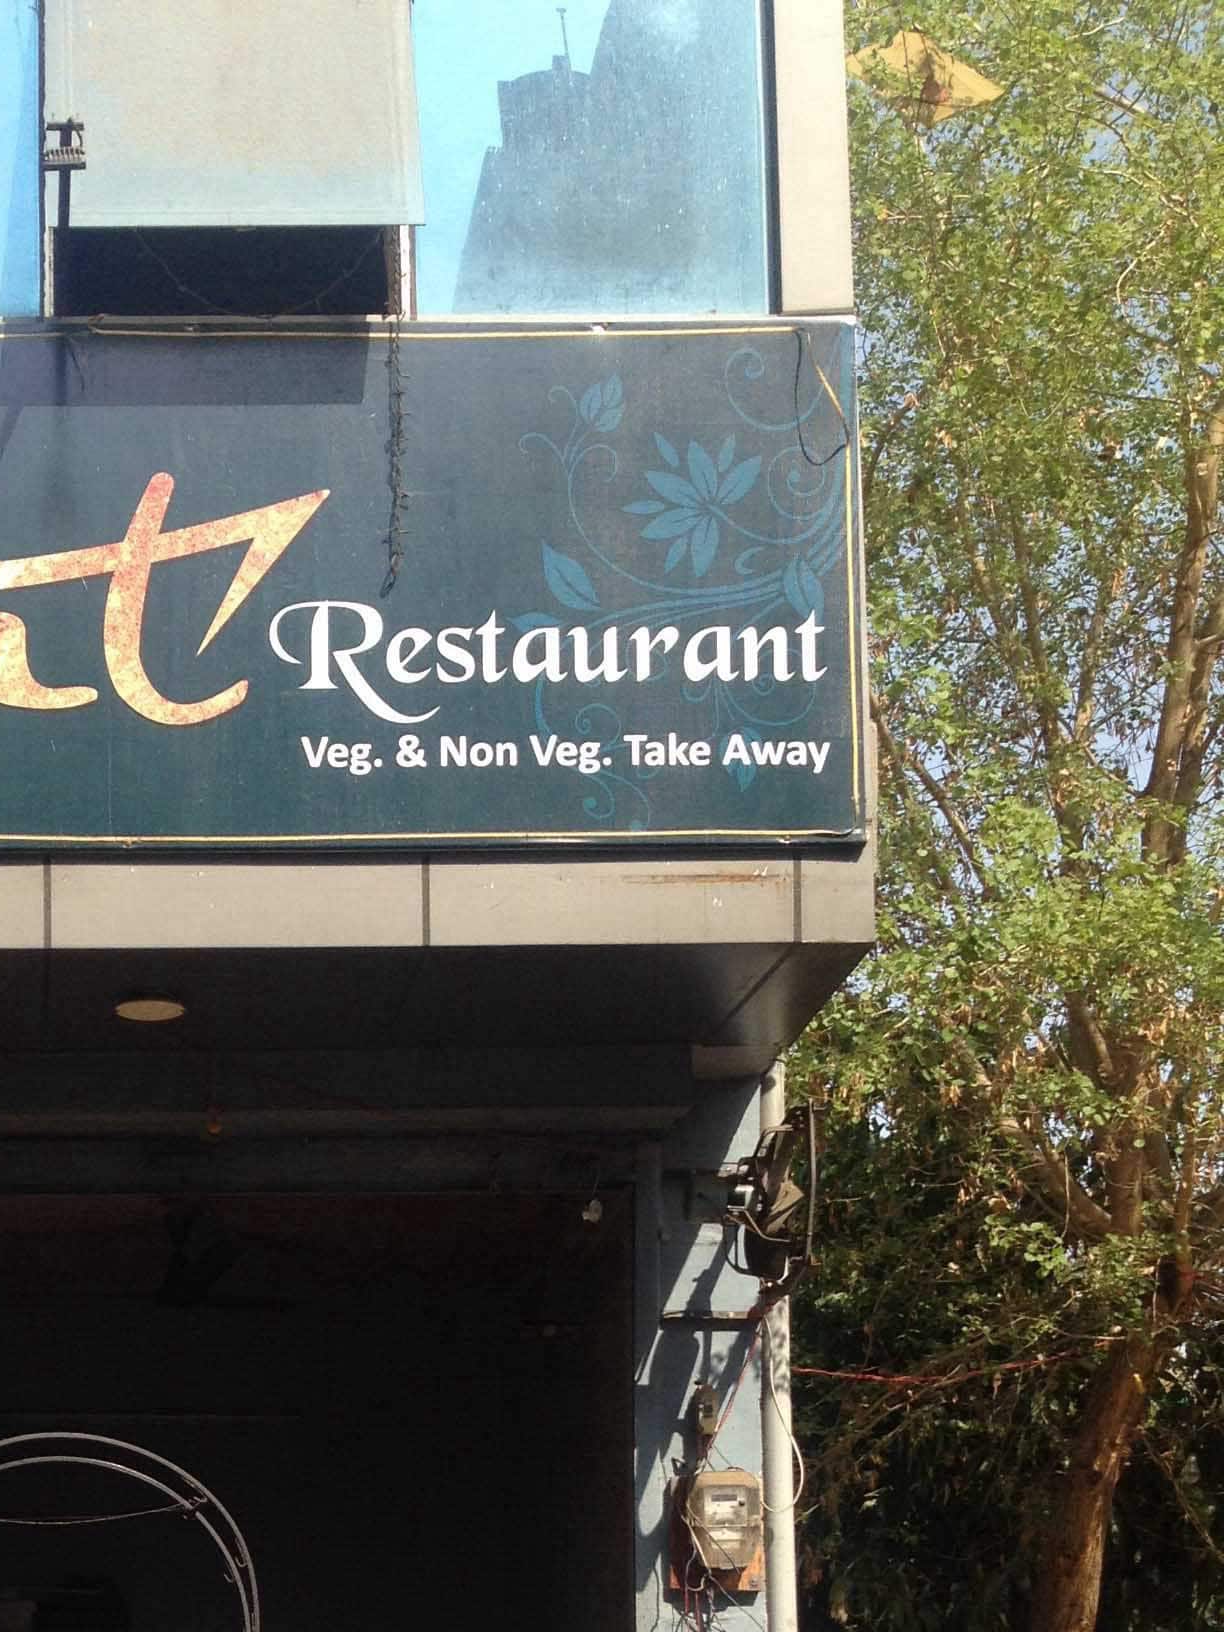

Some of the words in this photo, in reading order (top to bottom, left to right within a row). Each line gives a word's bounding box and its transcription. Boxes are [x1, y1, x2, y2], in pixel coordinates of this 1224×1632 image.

[269, 600, 828, 724] Restaurant
[300, 735, 383, 776] Veg.
[395, 734, 428, 768] &
[439, 735, 519, 768] Non
[528, 734, 613, 774] Veg.
[623, 731, 712, 767] Take
[721, 733, 831, 774] Away
